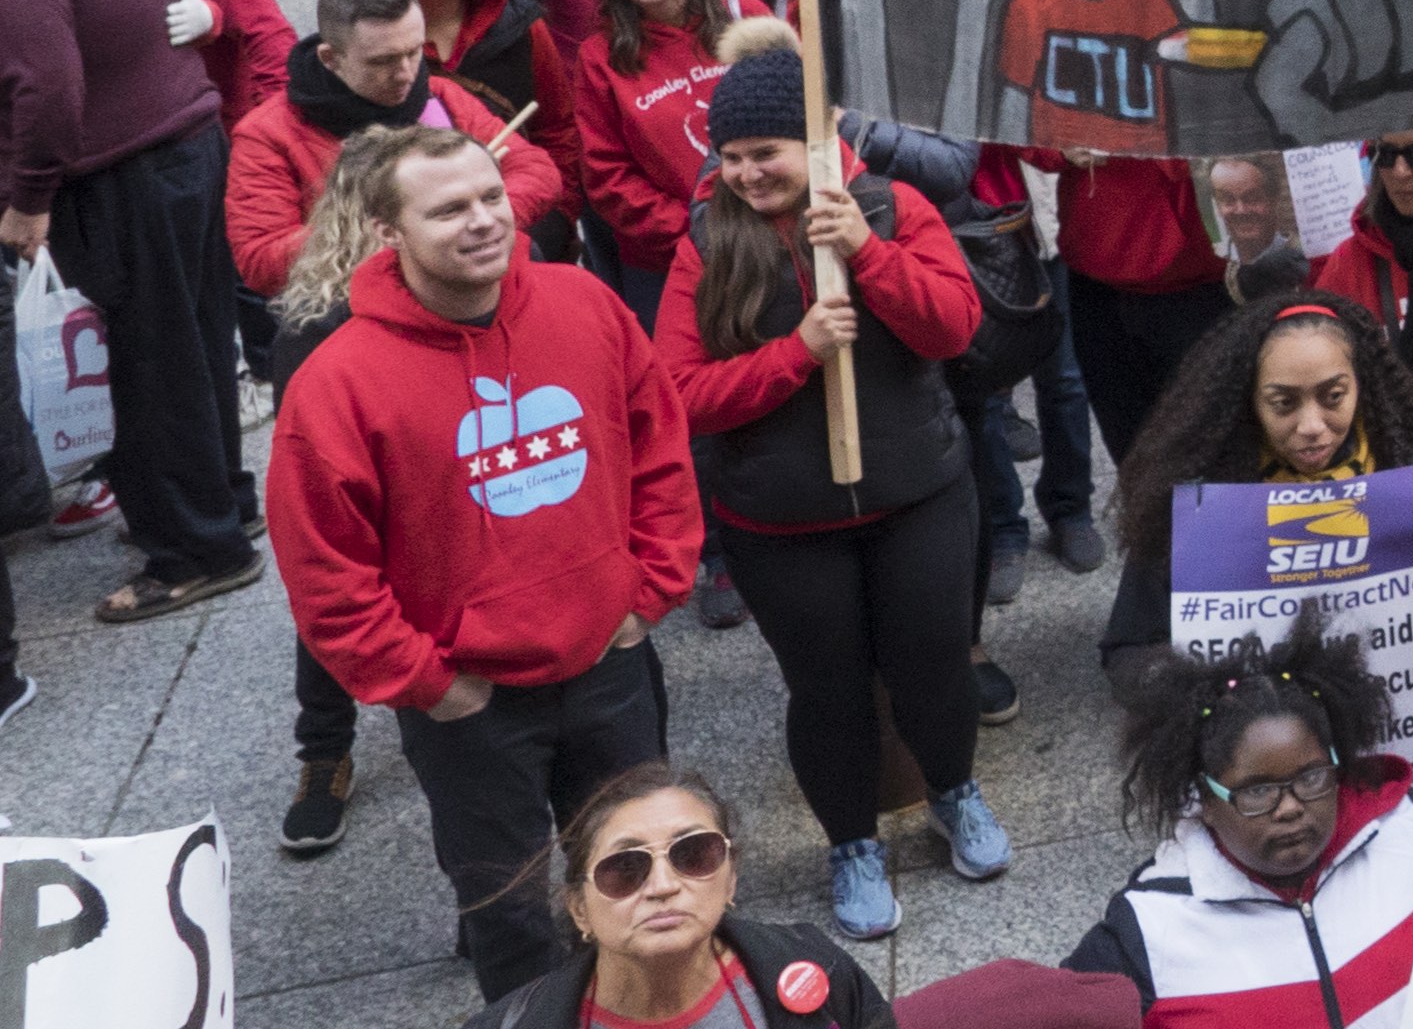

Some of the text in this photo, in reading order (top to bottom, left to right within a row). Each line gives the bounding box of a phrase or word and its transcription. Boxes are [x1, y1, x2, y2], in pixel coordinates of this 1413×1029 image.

[1046, 36, 1157, 120] CTU
[635, 76, 691, 111] Coonley
[526, 465, 581, 491] Elementary
[1267, 482, 1367, 505] LOCAL 73
[1267, 536, 1370, 573] SEIU
[1270, 563, 1371, 585] Stronger Together
